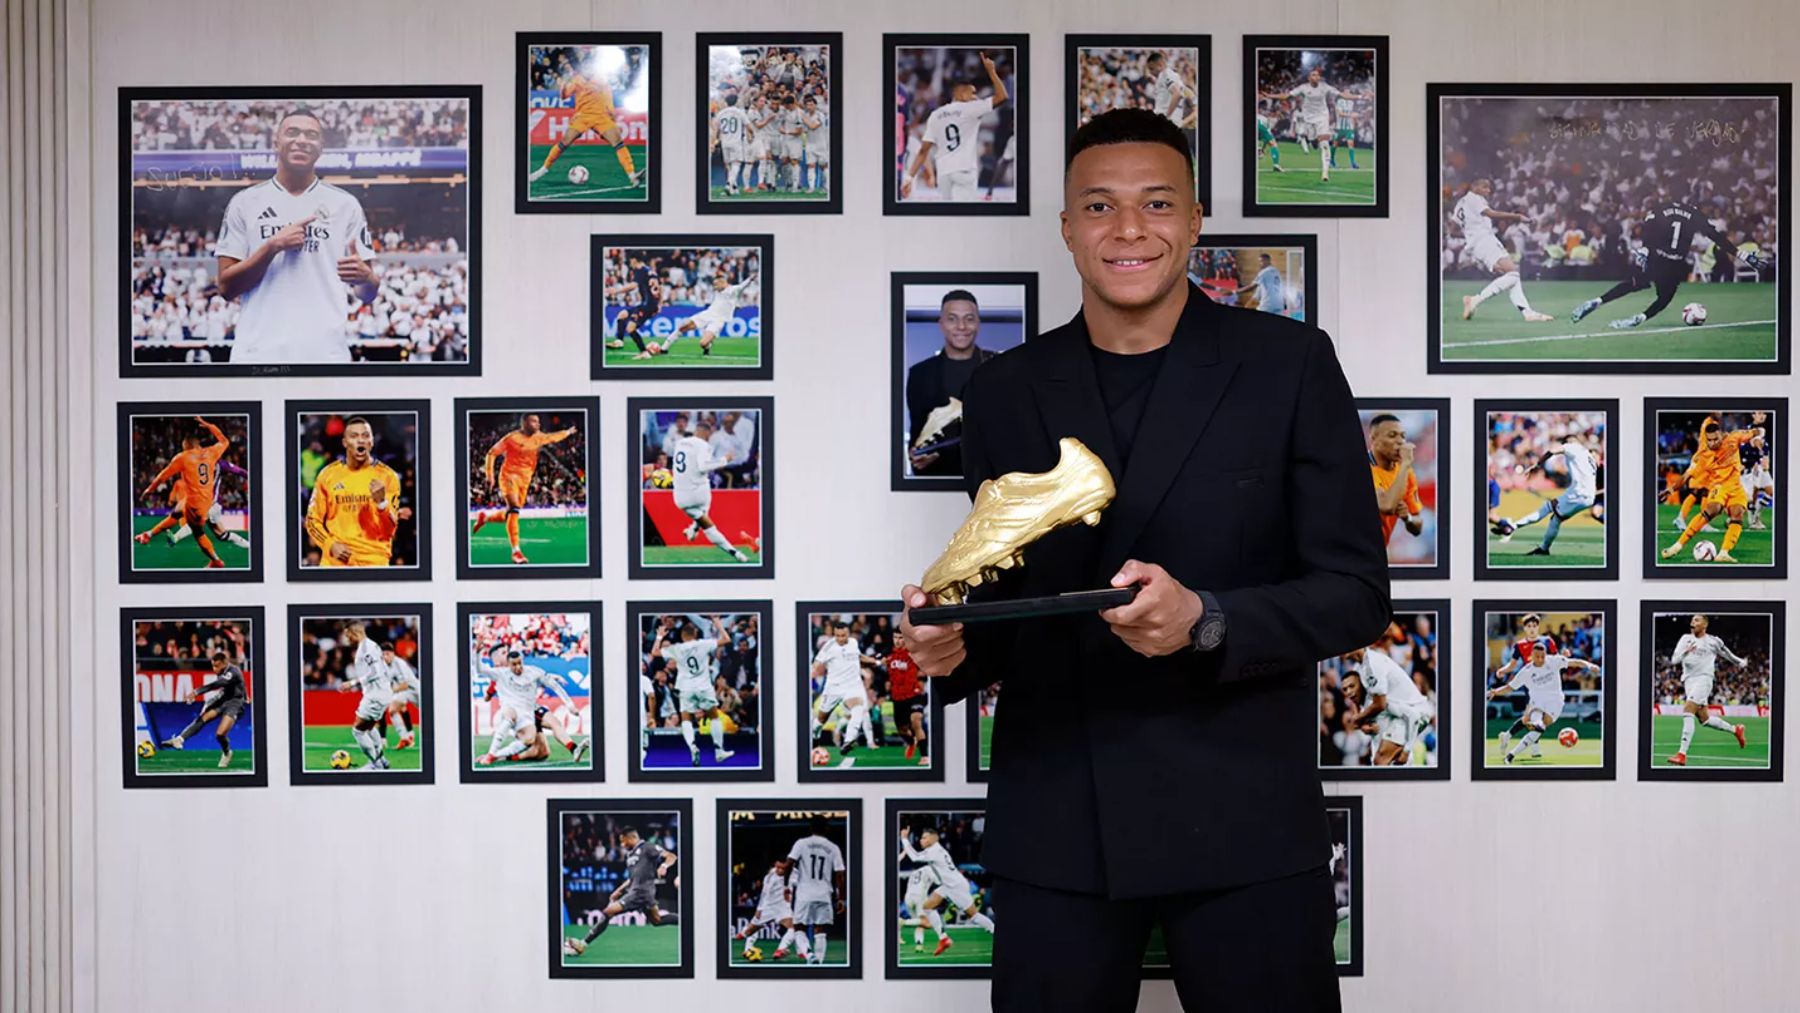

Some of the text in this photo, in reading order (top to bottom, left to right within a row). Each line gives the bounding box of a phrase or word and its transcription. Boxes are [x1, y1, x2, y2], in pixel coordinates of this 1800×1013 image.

[720, 117, 738, 134] 20
[945, 123, 960, 152] 9
[1671, 221, 1682, 249] 1
[676, 451, 686, 473] 9
[198, 463, 209, 485] 9
[686, 656, 700, 676] 9
[810, 854, 826, 880] 11
